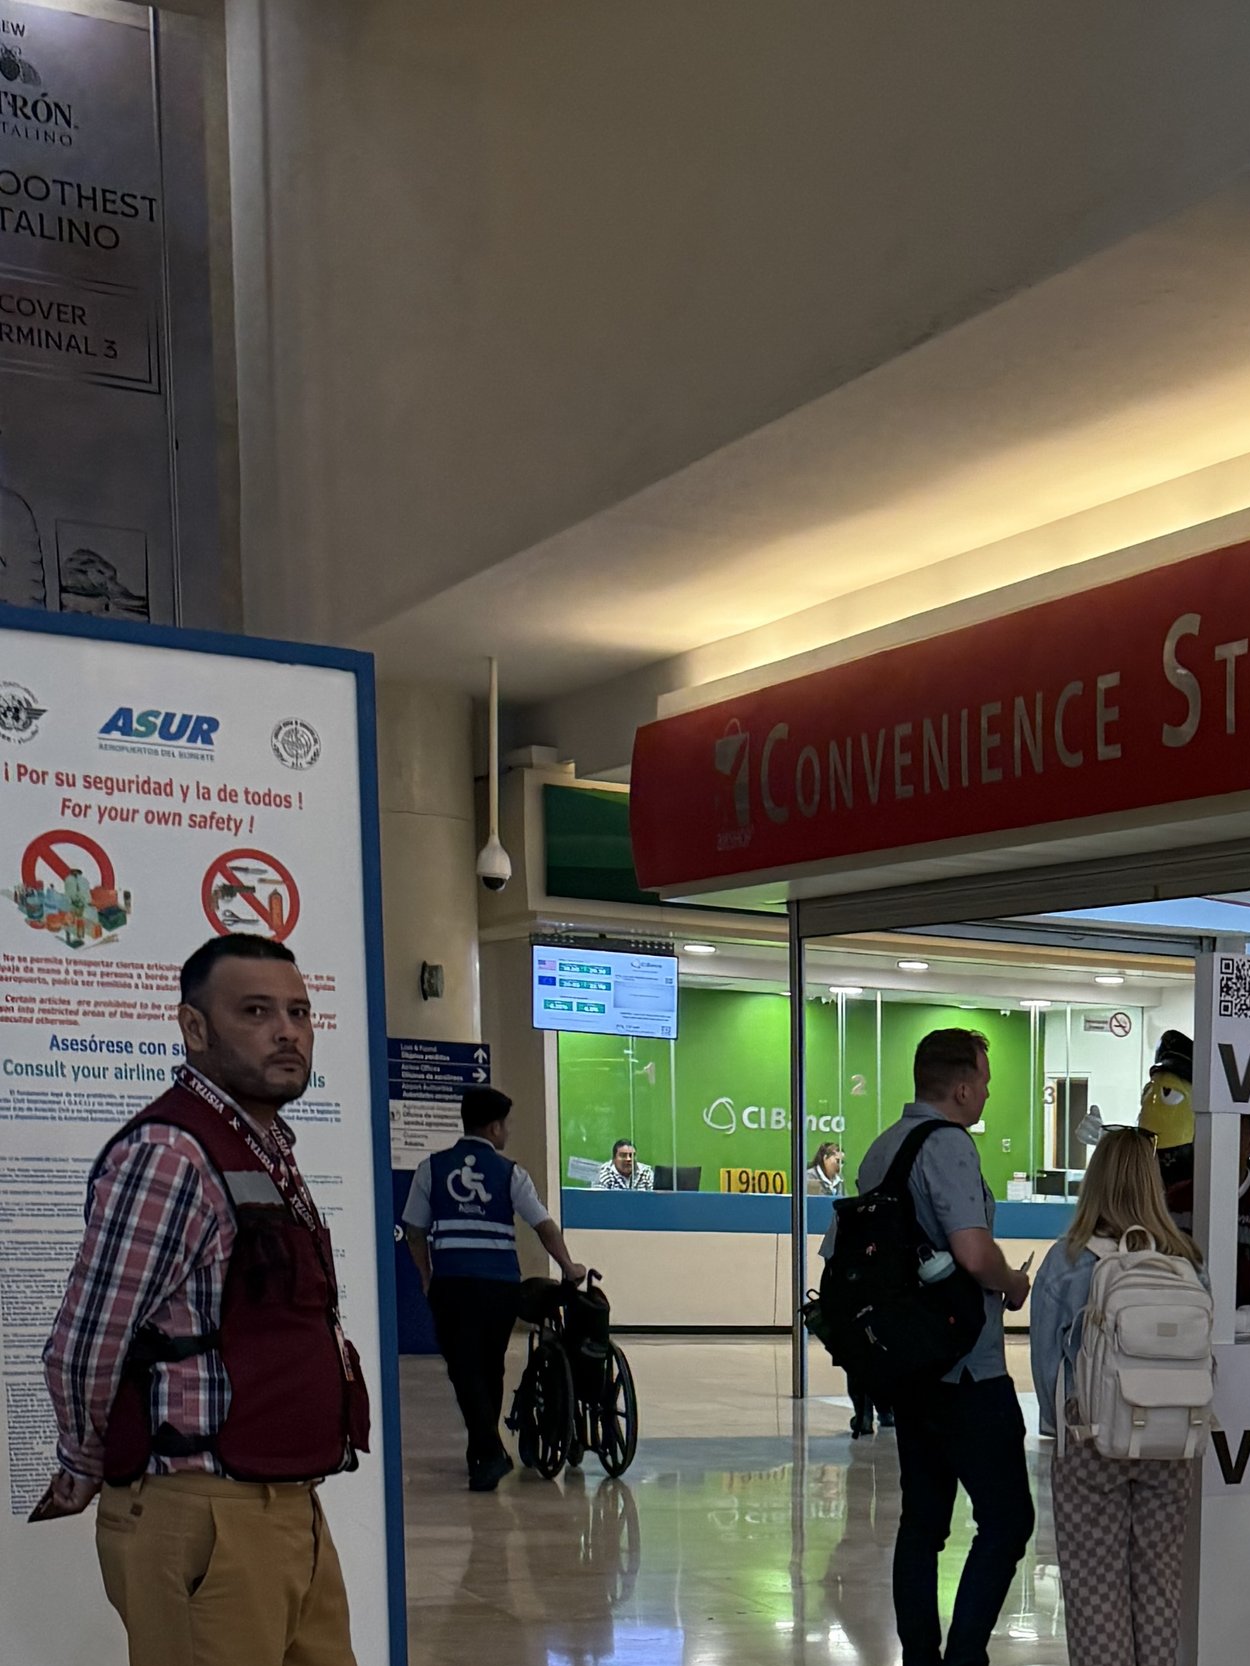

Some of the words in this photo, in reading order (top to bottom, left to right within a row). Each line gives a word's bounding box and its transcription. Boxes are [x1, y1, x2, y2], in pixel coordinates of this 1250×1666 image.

[1, 20, 25, 37] EW
[0, 91, 72, 129] TRÓN
[1, 122, 73, 147] TALINO
[0, 170, 157, 223] OOTHEST
[0, 206, 120, 250] TALINO
[0, 295, 87, 326] COVER
[0, 322, 97, 357] RMINAL
[103, 339, 118, 359] 3
[99, 707, 220, 745] ASUR
[761, 672, 1121, 824] CONVENIENCE
[16, 764, 48, 785] Por
[54, 771, 76, 788] su
[82, 774, 174, 798] seguridad
[180, 784, 190, 803] y
[196, 781, 211, 801] la
[217, 784, 238, 804] de
[243, 788, 292, 809] todos
[61, 798, 92, 818] For
[98, 804, 139, 824] your
[144, 810, 182, 827] own
[188, 812, 243, 836] safety
[50, 1034, 133, 1054] Asesórese
[139, 1042, 166, 1056] con
[3, 1059, 66, 1078] Consult
[72, 1066, 109, 1083] your
[114, 1063, 165, 1081] airline
[851, 1074, 866, 1096] 2
[1042, 1086, 1057, 1105] 3
